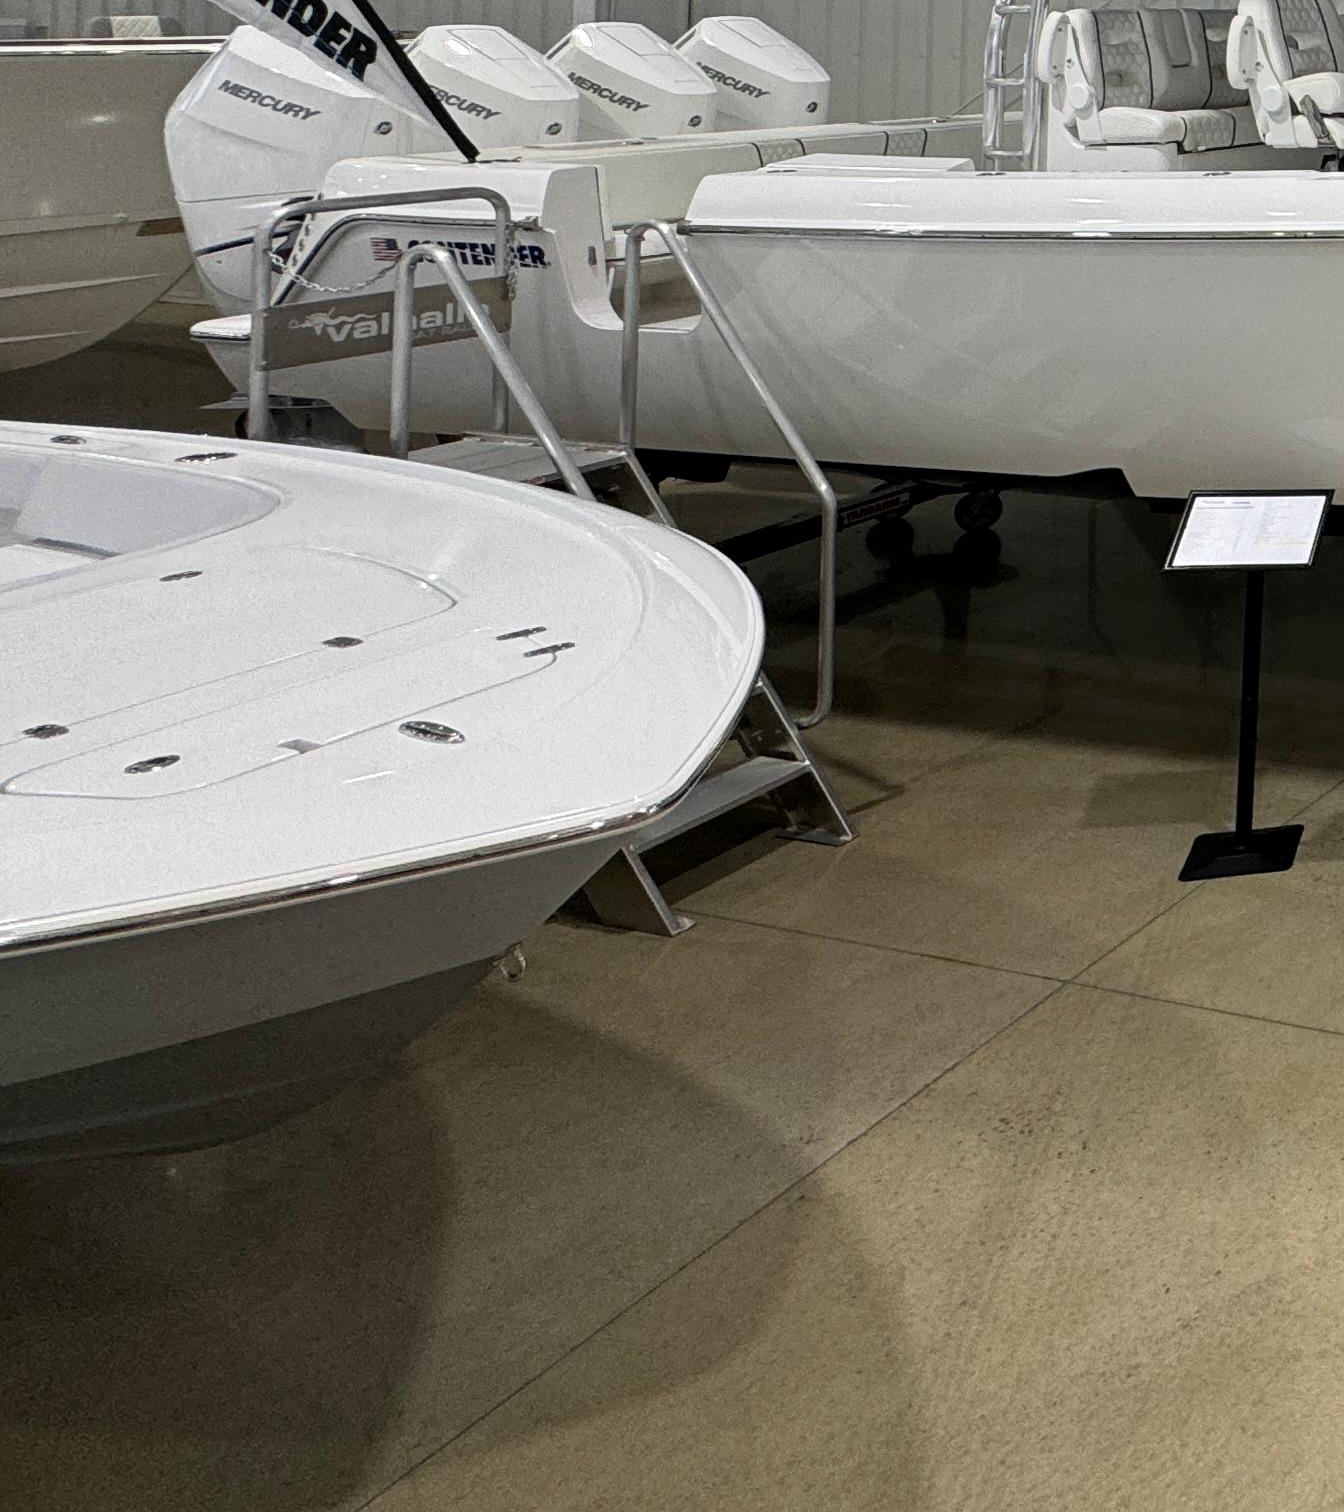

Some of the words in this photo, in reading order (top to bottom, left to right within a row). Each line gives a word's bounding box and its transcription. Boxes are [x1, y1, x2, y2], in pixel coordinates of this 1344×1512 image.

[218, 79, 322, 120] MERCURY
[428, 84, 502, 120] RCURY
[567, 71, 649, 112] MERCURY
[326, 303, 489, 342] valall
